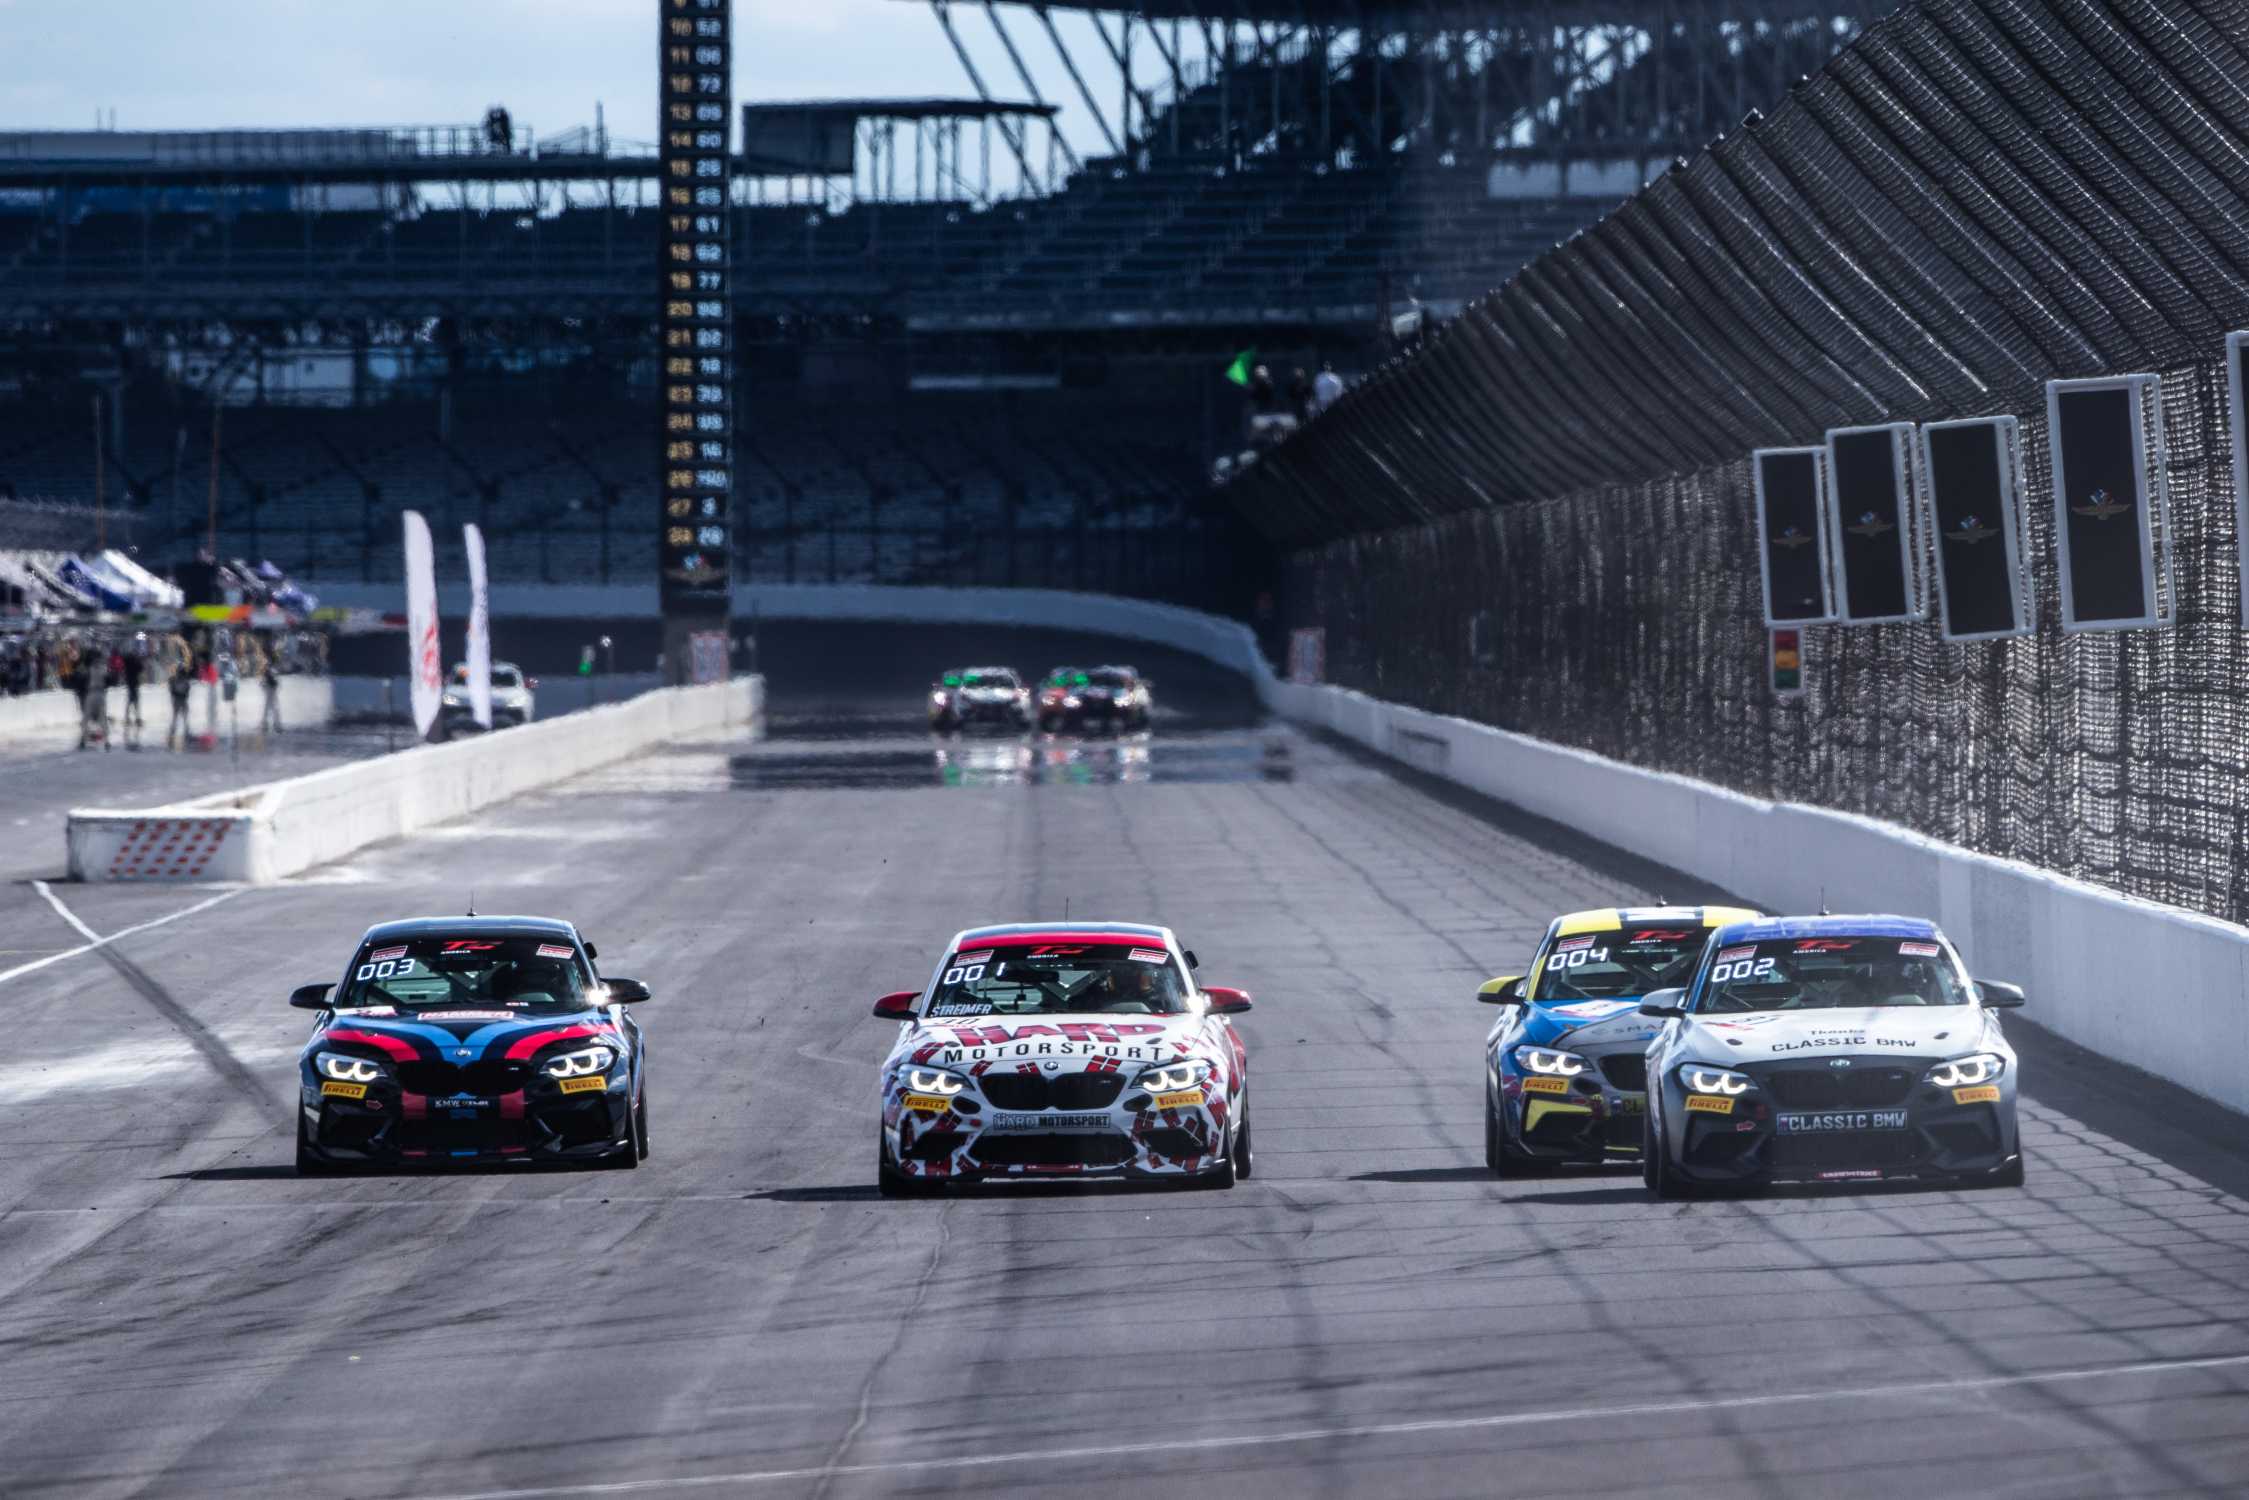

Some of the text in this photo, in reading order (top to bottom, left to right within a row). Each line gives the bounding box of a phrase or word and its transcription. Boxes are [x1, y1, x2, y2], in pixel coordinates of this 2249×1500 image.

[1547, 947, 1608, 971] 004
[356, 958, 416, 981] 003
[1711, 957, 1776, 983] 002
[951, 1023, 1167, 1047] HARD
[1771, 1036, 1917, 1052] CLASSIC BMW
[944, 1042, 1163, 1064] MOTORSPORT
[325, 1083, 362, 1096] PIRELLI
[1525, 1079, 1564, 1091] PIRELLI
[906, 1097, 946, 1109] PIRELLI
[1158, 1093, 1200, 1105] PIRELLI
[1688, 1098, 1729, 1110] PIRELLI
[1039, 1114, 1109, 1129] MOTORSPORT
[1789, 1112, 1905, 1130] CLASSIC BMW
